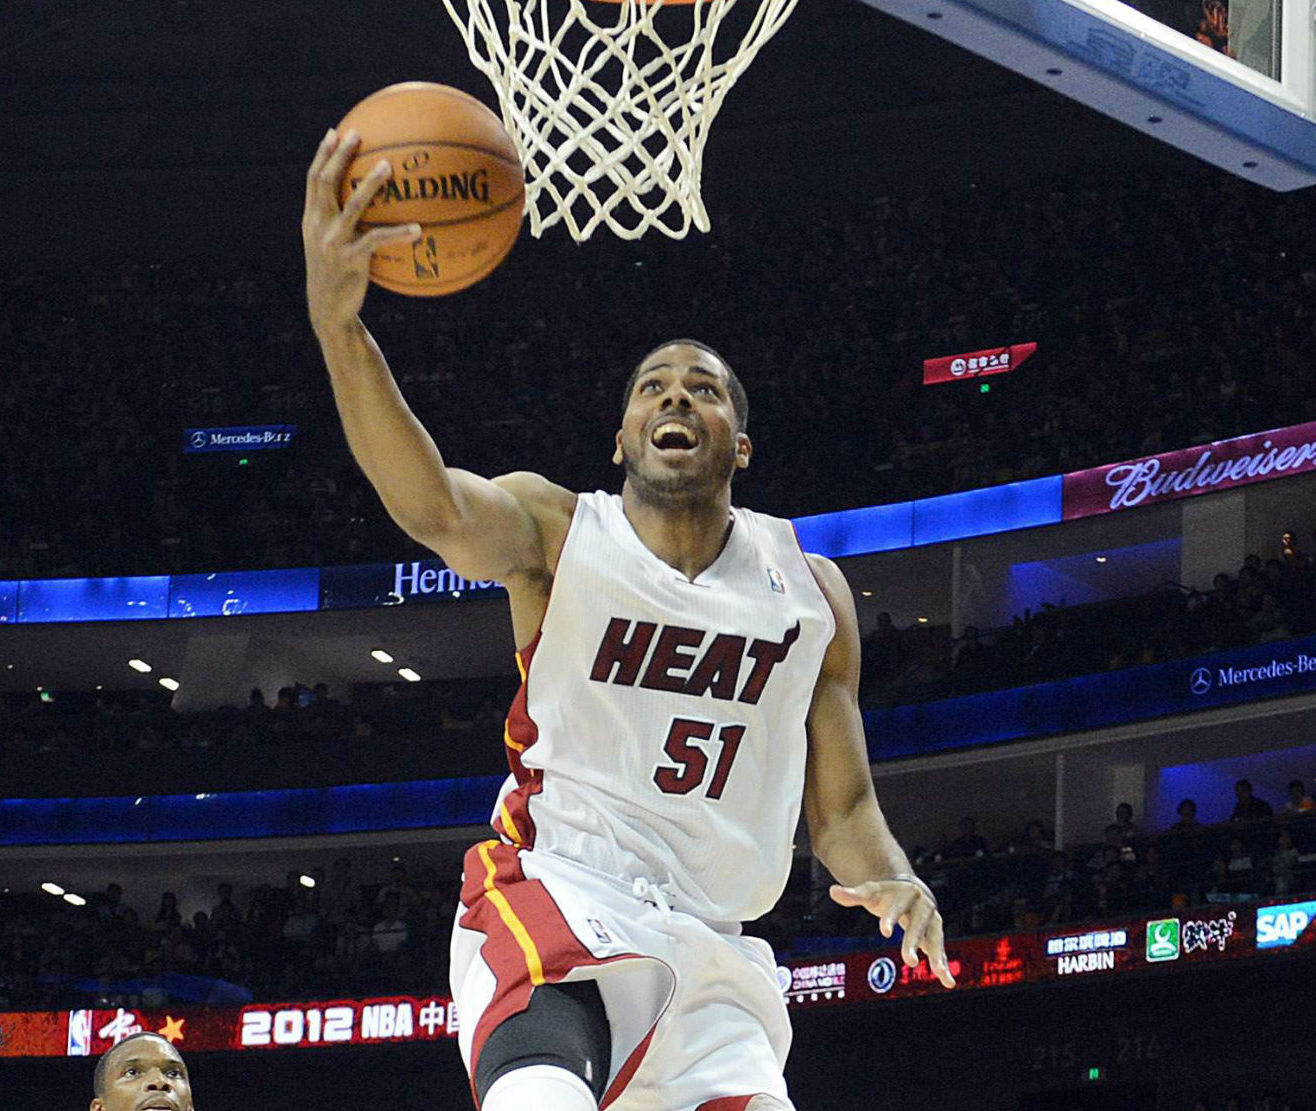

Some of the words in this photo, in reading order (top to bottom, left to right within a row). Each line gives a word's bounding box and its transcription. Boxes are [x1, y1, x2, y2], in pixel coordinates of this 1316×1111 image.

[351, 168, 489, 207] ALDING
[589, 616, 800, 705] HEAT
[651, 717, 747, 801] 51
[1257, 911, 1309, 943] SAP
[1057, 950, 1115, 975] HARBIN
[241, 1007, 354, 1046] 2012
[361, 1002, 414, 1039] NBA
[1031, 1044, 1076, 1071] 215
[1115, 1035, 1161, 1061] 216
